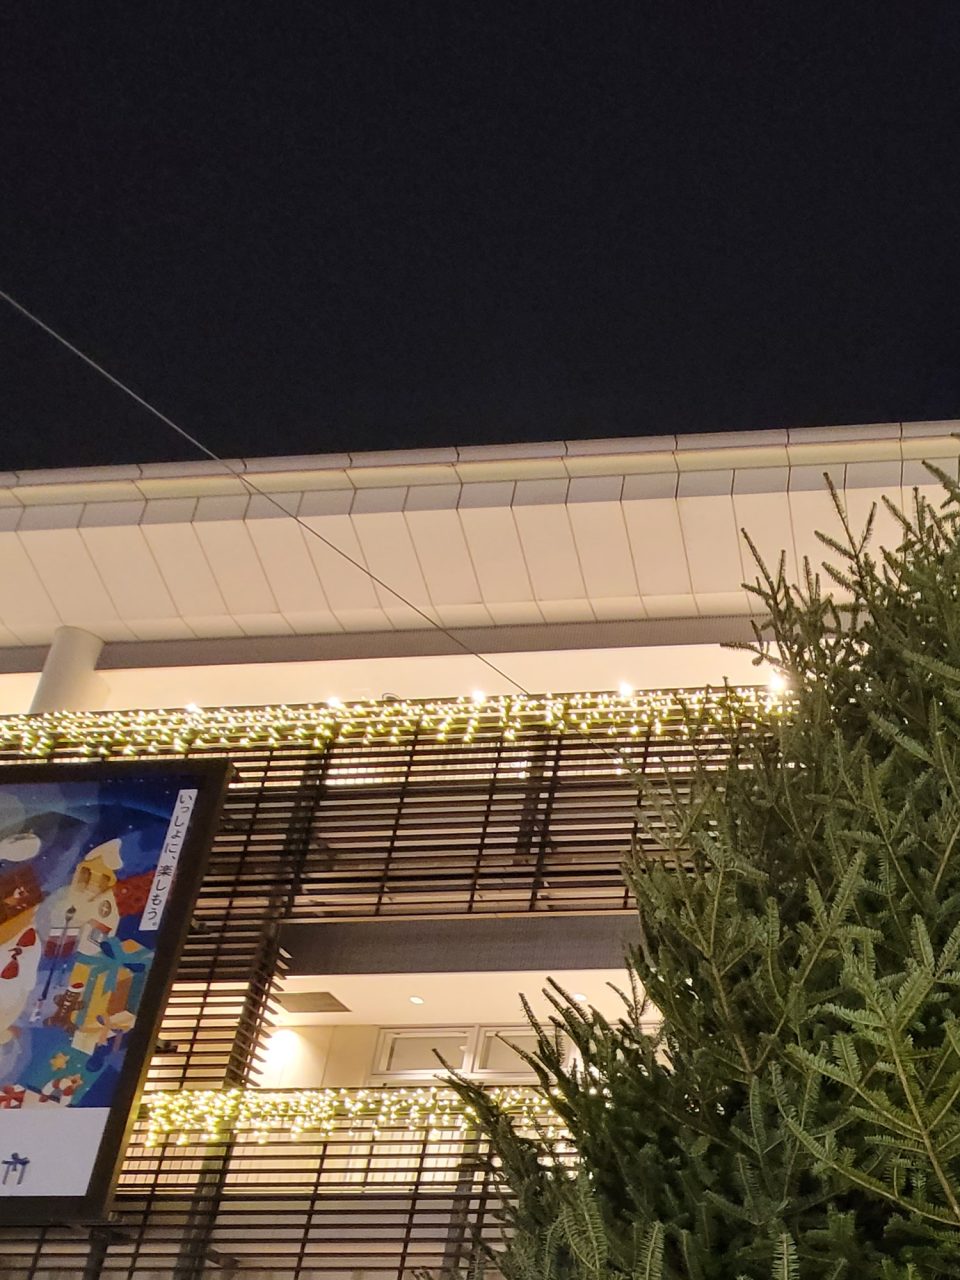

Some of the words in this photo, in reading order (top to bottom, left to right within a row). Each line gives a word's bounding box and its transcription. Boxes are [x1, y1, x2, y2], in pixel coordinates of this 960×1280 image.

[147, 794, 193, 927] いっしょに、楽しもう。
